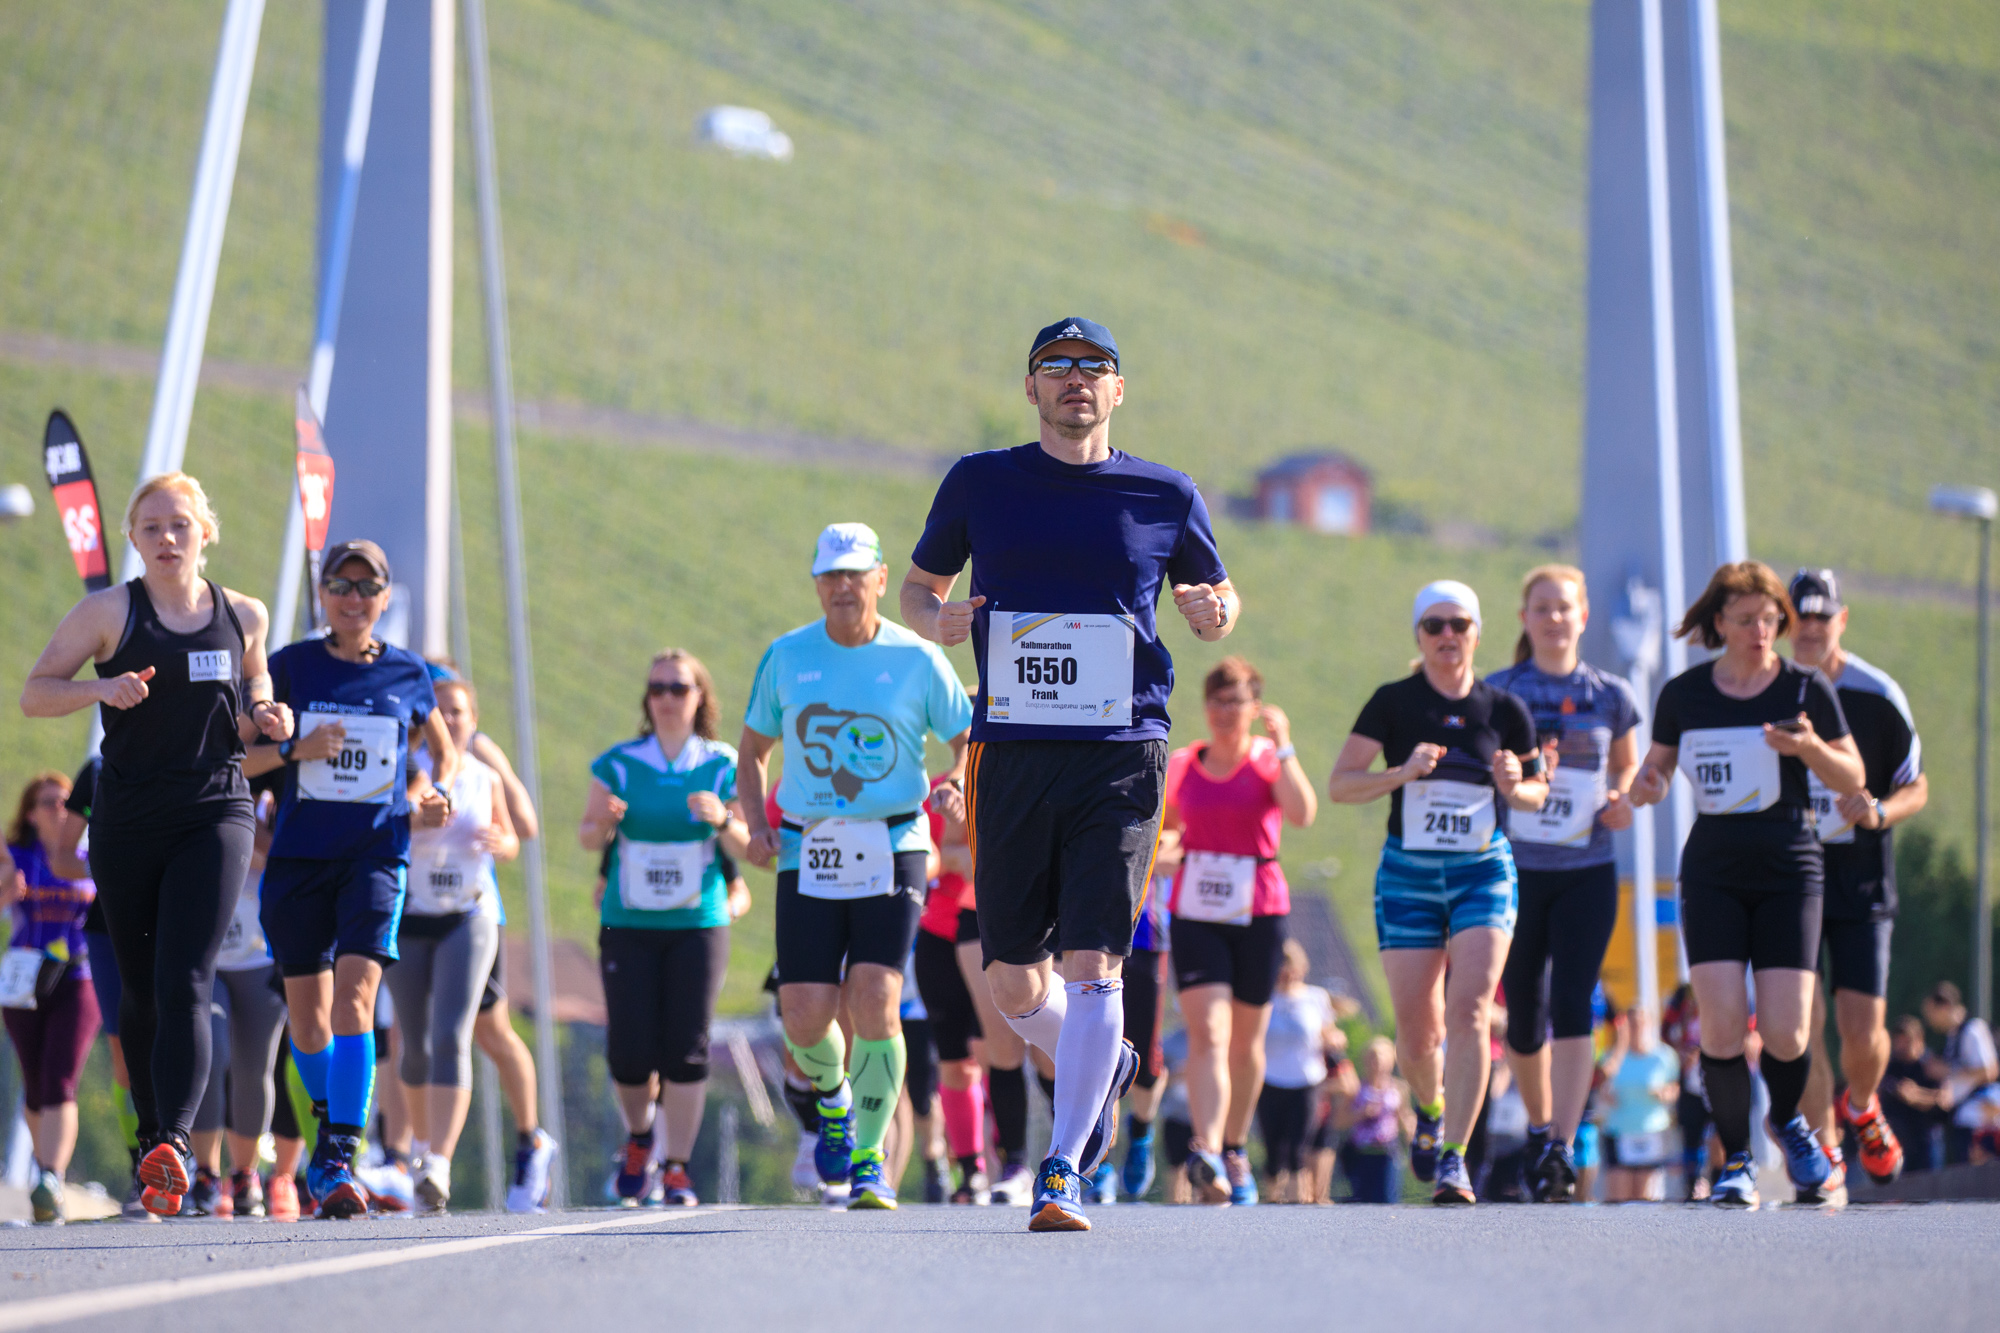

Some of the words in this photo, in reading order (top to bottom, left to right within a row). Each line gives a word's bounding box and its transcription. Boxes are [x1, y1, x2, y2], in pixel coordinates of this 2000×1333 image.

[1020, 641, 1072, 650] Halbmarathon
[195, 654, 227, 668] 1110
[1014, 656, 1078, 685] 1550
[1031, 689, 1059, 700] Frank
[1696, 762, 1732, 784] 1761
[1424, 812, 1472, 834] 2419
[808, 848, 844, 869] 322
